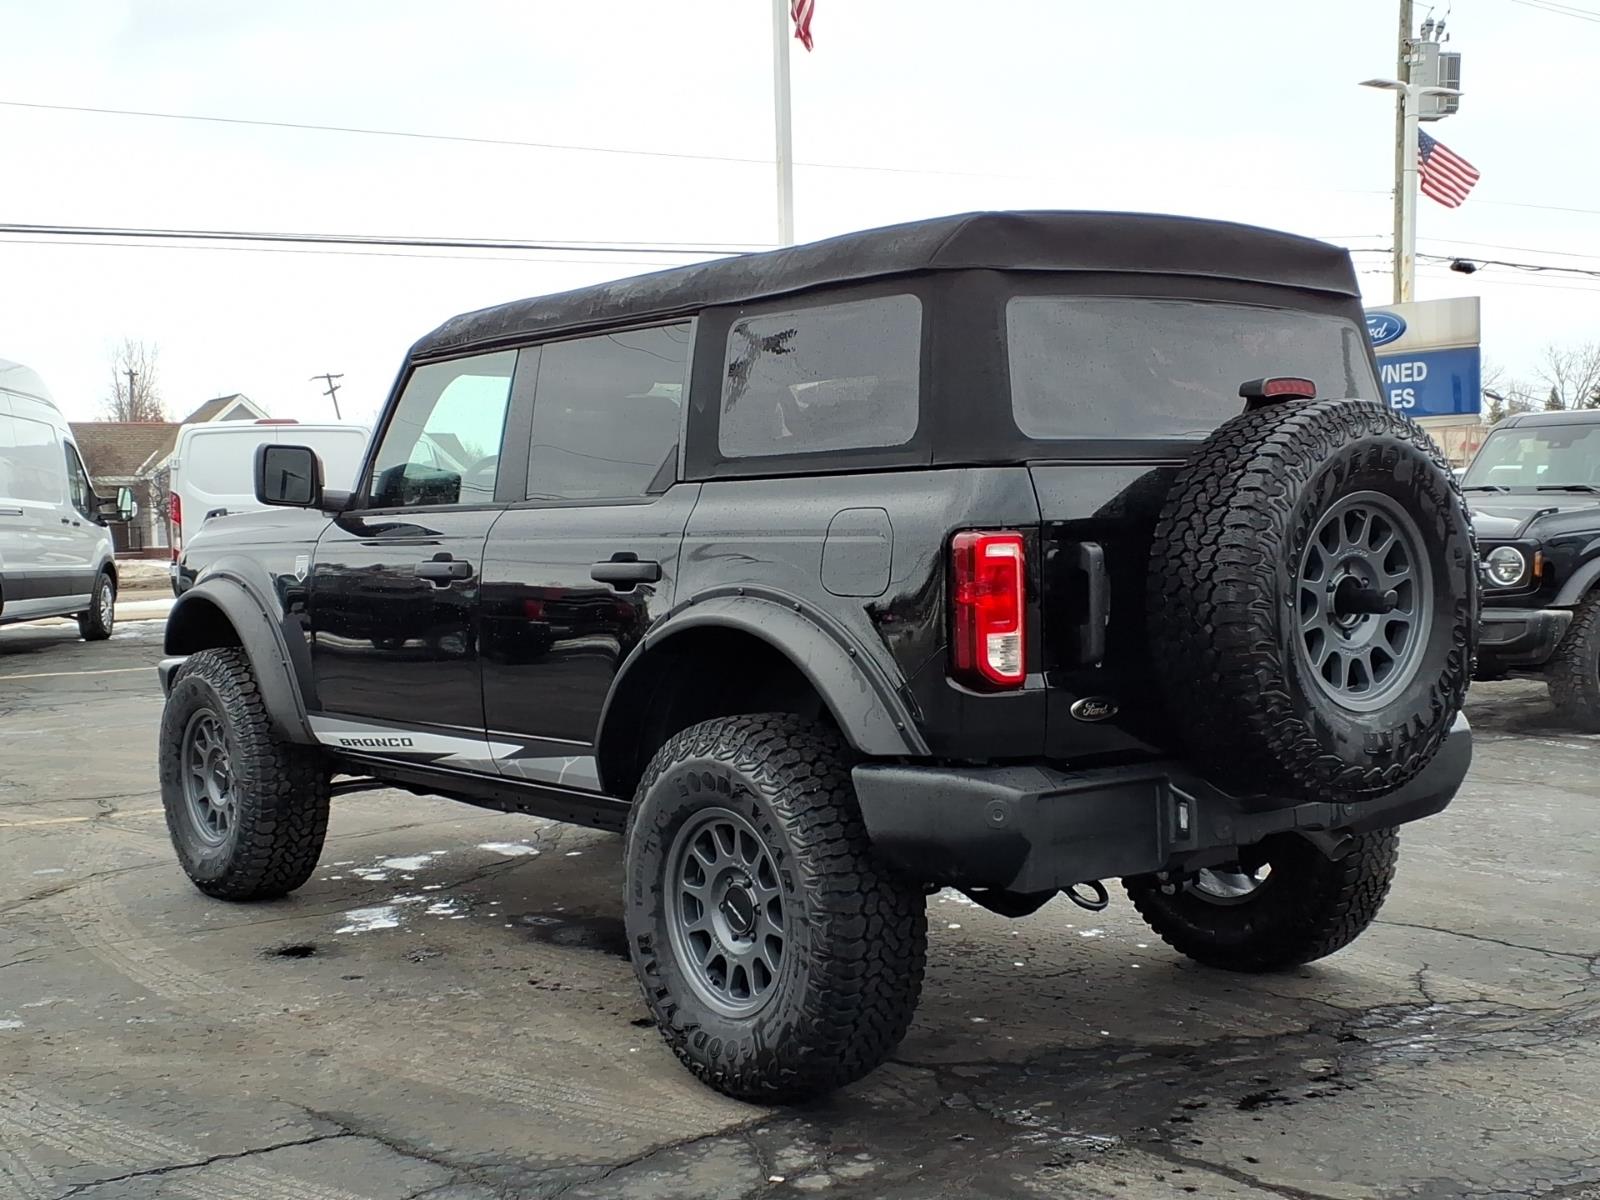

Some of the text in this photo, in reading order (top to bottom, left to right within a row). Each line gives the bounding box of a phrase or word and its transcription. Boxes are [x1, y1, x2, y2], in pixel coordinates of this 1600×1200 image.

[1390, 388, 1415, 408] ES
[1083, 702, 1109, 716] Ford
[338, 738, 414, 747] BRONCO
